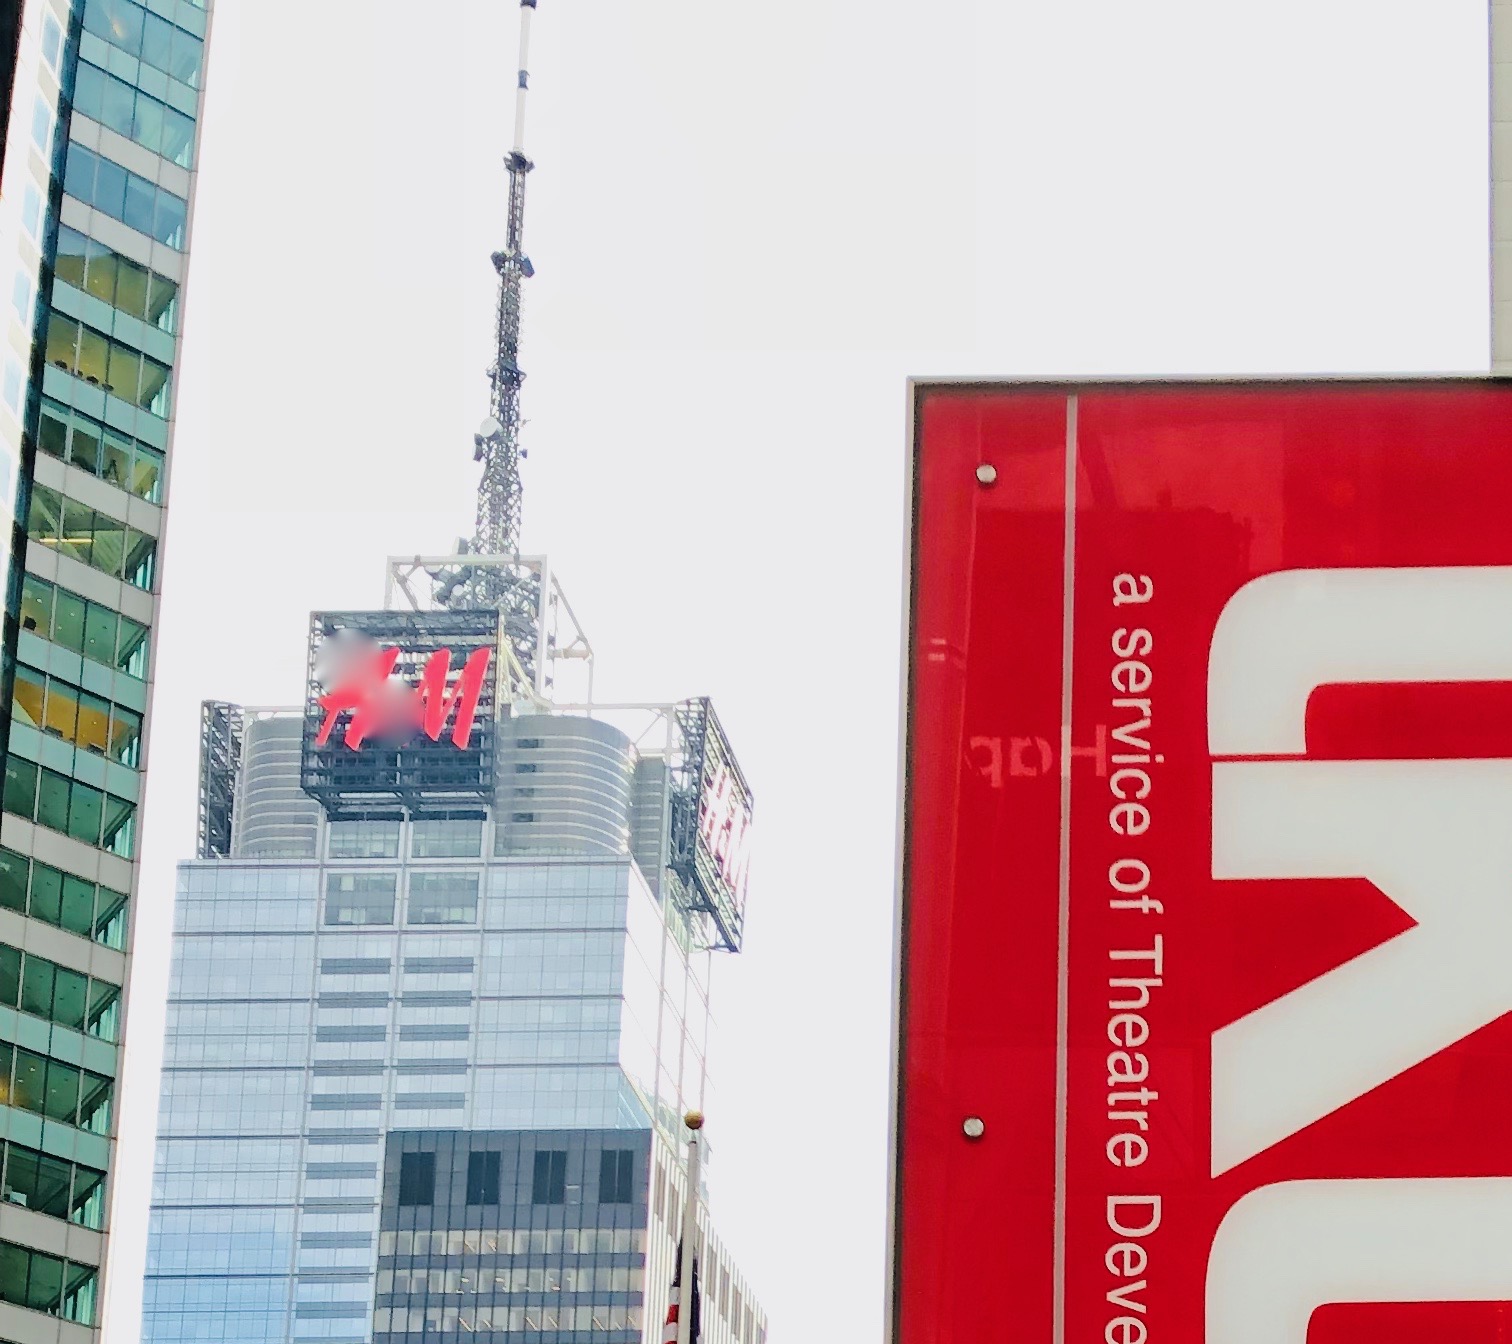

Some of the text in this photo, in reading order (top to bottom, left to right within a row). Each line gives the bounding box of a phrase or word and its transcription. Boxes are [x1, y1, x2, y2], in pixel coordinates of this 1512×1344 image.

[1111, 571, 1155, 607] a
[1108, 627, 1165, 837] service
[1107, 857, 1164, 915] of
[1105, 933, 1164, 1168] Theatre
